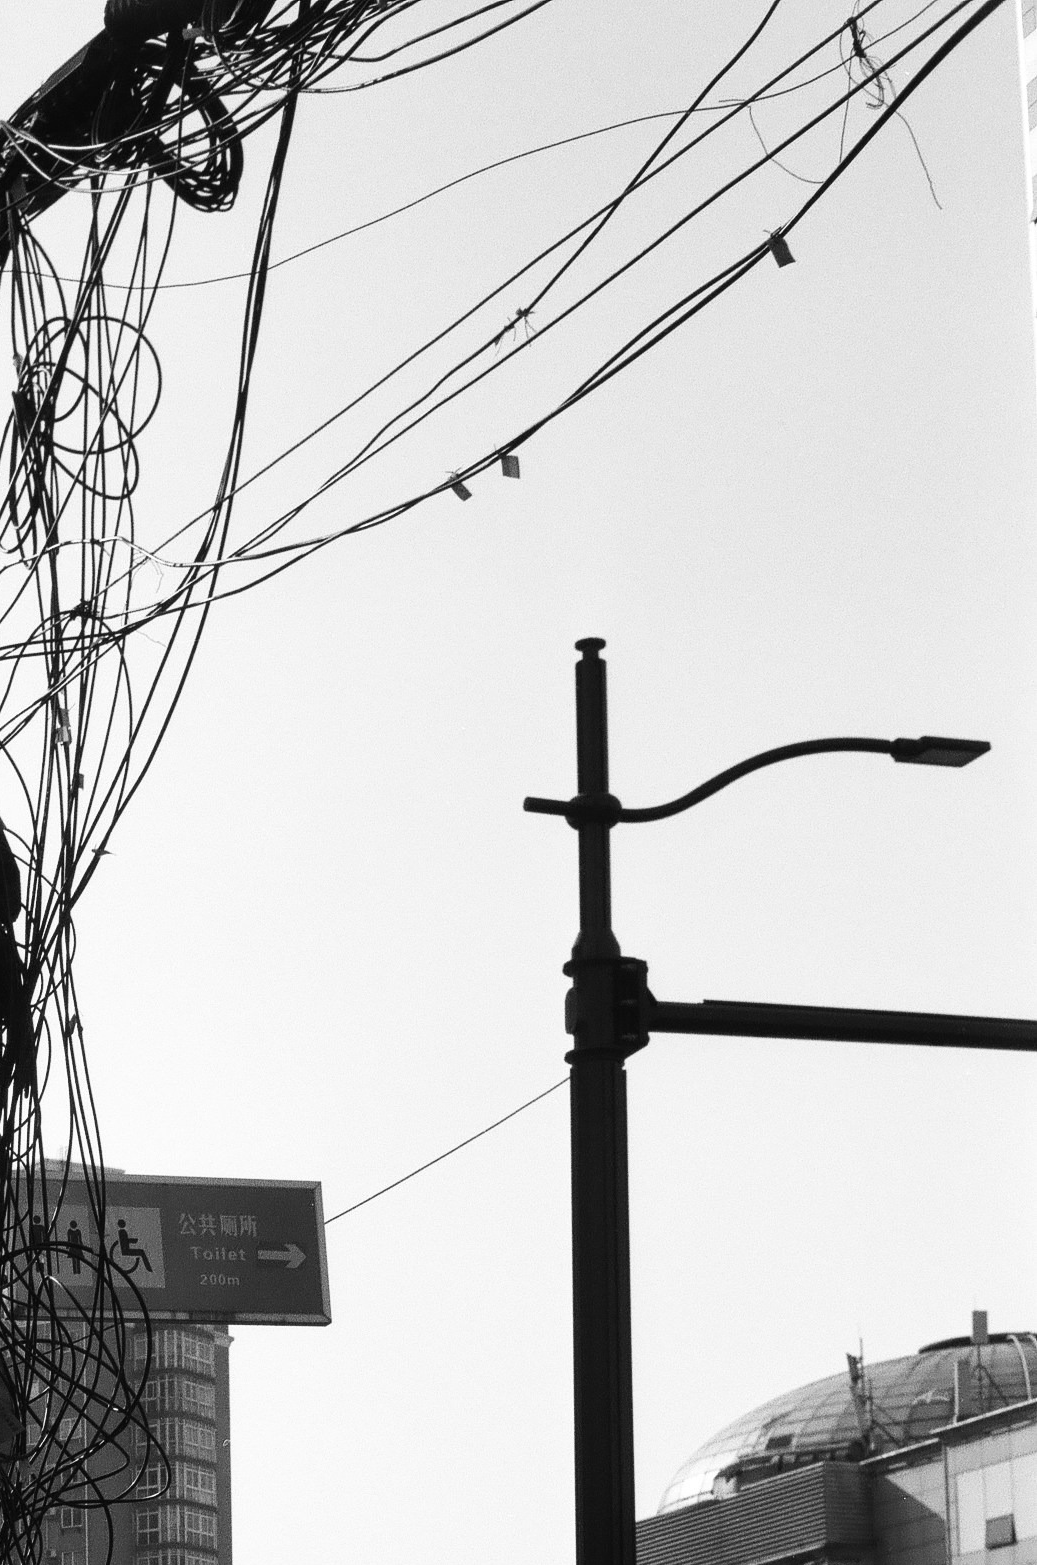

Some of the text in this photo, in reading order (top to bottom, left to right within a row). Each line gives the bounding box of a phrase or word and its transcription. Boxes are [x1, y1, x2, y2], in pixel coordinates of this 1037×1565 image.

[179, 1213, 257, 1238] 公共厕所
[190, 1246, 246, 1262] Toilet
[199, 1273, 240, 1286] 200m
